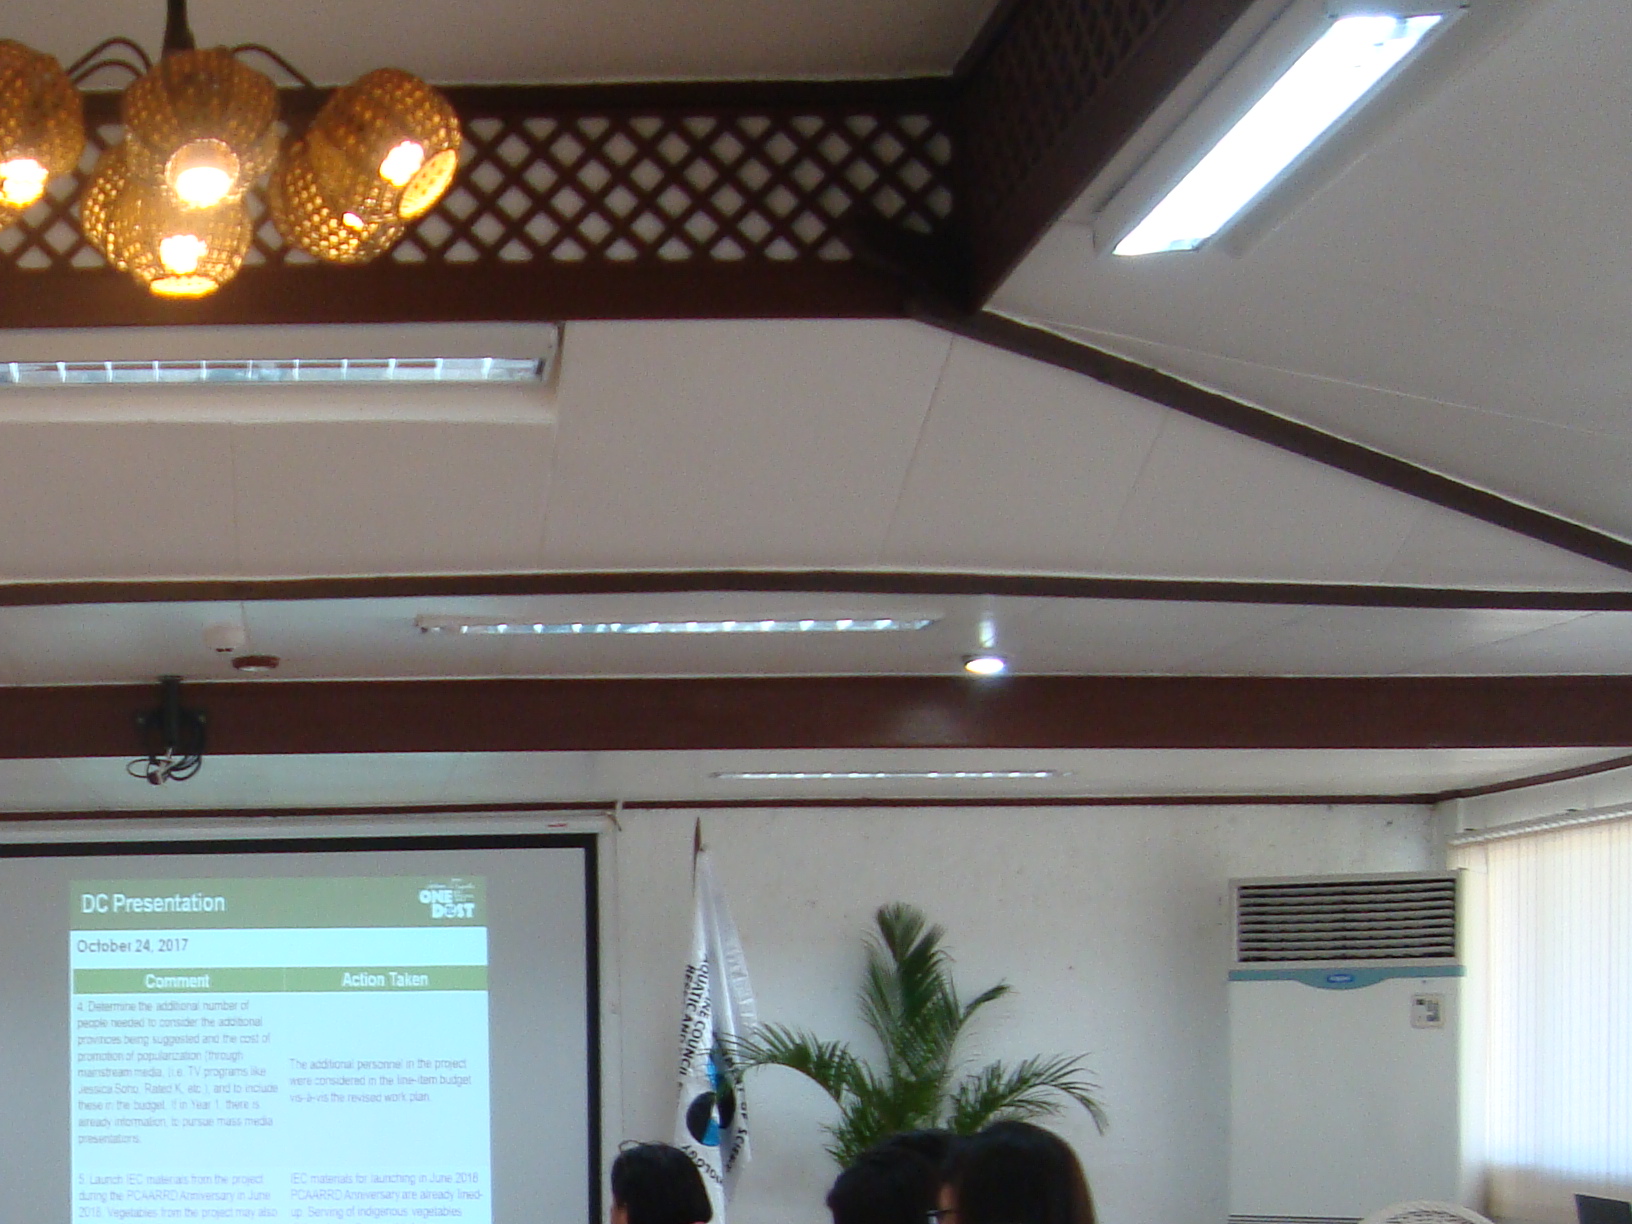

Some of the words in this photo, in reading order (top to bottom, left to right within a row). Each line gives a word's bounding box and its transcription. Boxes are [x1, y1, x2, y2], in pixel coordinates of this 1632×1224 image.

[81, 894, 109, 913] DC
[113, 893, 226, 912] Presentation
[419, 890, 453, 903] ONE
[77, 939, 131, 954] October
[135, 939, 153, 954] 24,
[158, 938, 188, 952] 2017
[146, 974, 210, 989] Comment
[342, 972, 385, 987] Action
[389, 972, 428, 987] Taken
[88, 1000, 136, 1011] Determine
[138, 1000, 152, 1011] the
[155, 1000, 199, 1011] additional
[203, 1000, 237, 1011] number
[240, 1000, 249, 1011] of
[77, 1017, 107, 1029] people
[110, 1017, 144, 1028] needed
[148, 1017, 156, 1028] to
[159, 1017, 197, 1028] consider
[201, 1017, 215, 1028] the
[218, 1017, 263, 1028] additional
[77, 1033, 122, 1046] provinces
[124, 1033, 149, 1046] being
[152, 1033, 200, 1046] suggested
[202, 1033, 220, 1045] and
[223, 1033, 237, 1045] the
[239, 1033, 259, 1045] cost
[261, 1033, 270, 1045] of
[77, 1050, 123, 1063] promotion
[137, 1050, 202, 1063] popularization
[289, 1058, 307, 1069] The
[309, 1058, 354, 1069] additional
[357, 1058, 402, 1071] personnel
[405, 1058, 415, 1069] in
[416, 1058, 432, 1069] the
[434, 1058, 467, 1071] project
[77, 1066, 132, 1077] mainstream
[188, 1066, 202, 1077] TV
[203, 1068, 248, 1079] programs
[250, 1066, 266, 1077] like
[289, 1077, 312, 1086] were
[314, 1074, 365, 1086] considered
[368, 1074, 377, 1086] in
[379, 1074, 394, 1086] the
[397, 1074, 437, 1086] line-item
[439, 1074, 472, 1087] budget
[78, 1083, 113, 1094] Jessica
[213, 1083, 231, 1094] and
[233, 1083, 243, 1094] to
[245, 1083, 279, 1094] include
[330, 1092, 345, 1101] the
[347, 1092, 382, 1101] revised
[383, 1092, 406, 1101] work
[77, 1099, 103, 1111] these
[105, 1099, 113, 1111] in
[116, 1099, 130, 1111] the
[191, 1099, 211, 1111] Year
[225, 1099, 250, 1111] there
[251, 1099, 260, 1111] is
[77, 1116, 111, 1129] already
[182, 1119, 214, 1129] pursue
[216, 1119, 242, 1128] mass
[244, 1116, 274, 1128] media
[89, 1173, 123, 1185] Launch
[126, 1173, 144, 1185] IEC
[146, 1173, 189, 1185] materials
[191, 1173, 212, 1185] from
[214, 1173, 229, 1185] the
[231, 1173, 264, 1186] project
[290, 1172, 307, 1184] IEC
[310, 1172, 353, 1184] materials
[355, 1172, 367, 1184] for
[370, 1172, 416, 1185] launching
[418, 1172, 428, 1184] in
[429, 1172, 453, 1184] June
[455, 1172, 479, 1184] 2018
[78, 1190, 108, 1203] during
[109, 1190, 124, 1202] the
[126, 1190, 178, 1202] PCAARRD
[180, 1190, 236, 1203] Anniversary
[237, 1190, 246, 1202] in
[247, 1190, 271, 1202] June
[290, 1189, 343, 1201] PCAARRD
[344, 1189, 401, 1202] Anniversary
[401, 1192, 417, 1201] are
[419, 1189, 454, 1202] already
[107, 1207, 158, 1220] Vegetables
[160, 1207, 182, 1218] from
[184, 1207, 198, 1218] the
[201, 1207, 234, 1220] project
[235, 1209, 255, 1220] may
[257, 1207, 278, 1218] also
[308, 1206, 344, 1219] Serving
[346, 1206, 355, 1218] of
[357, 1206, 408, 1219] indigenous
[411, 1206, 462, 1219] vegetables
